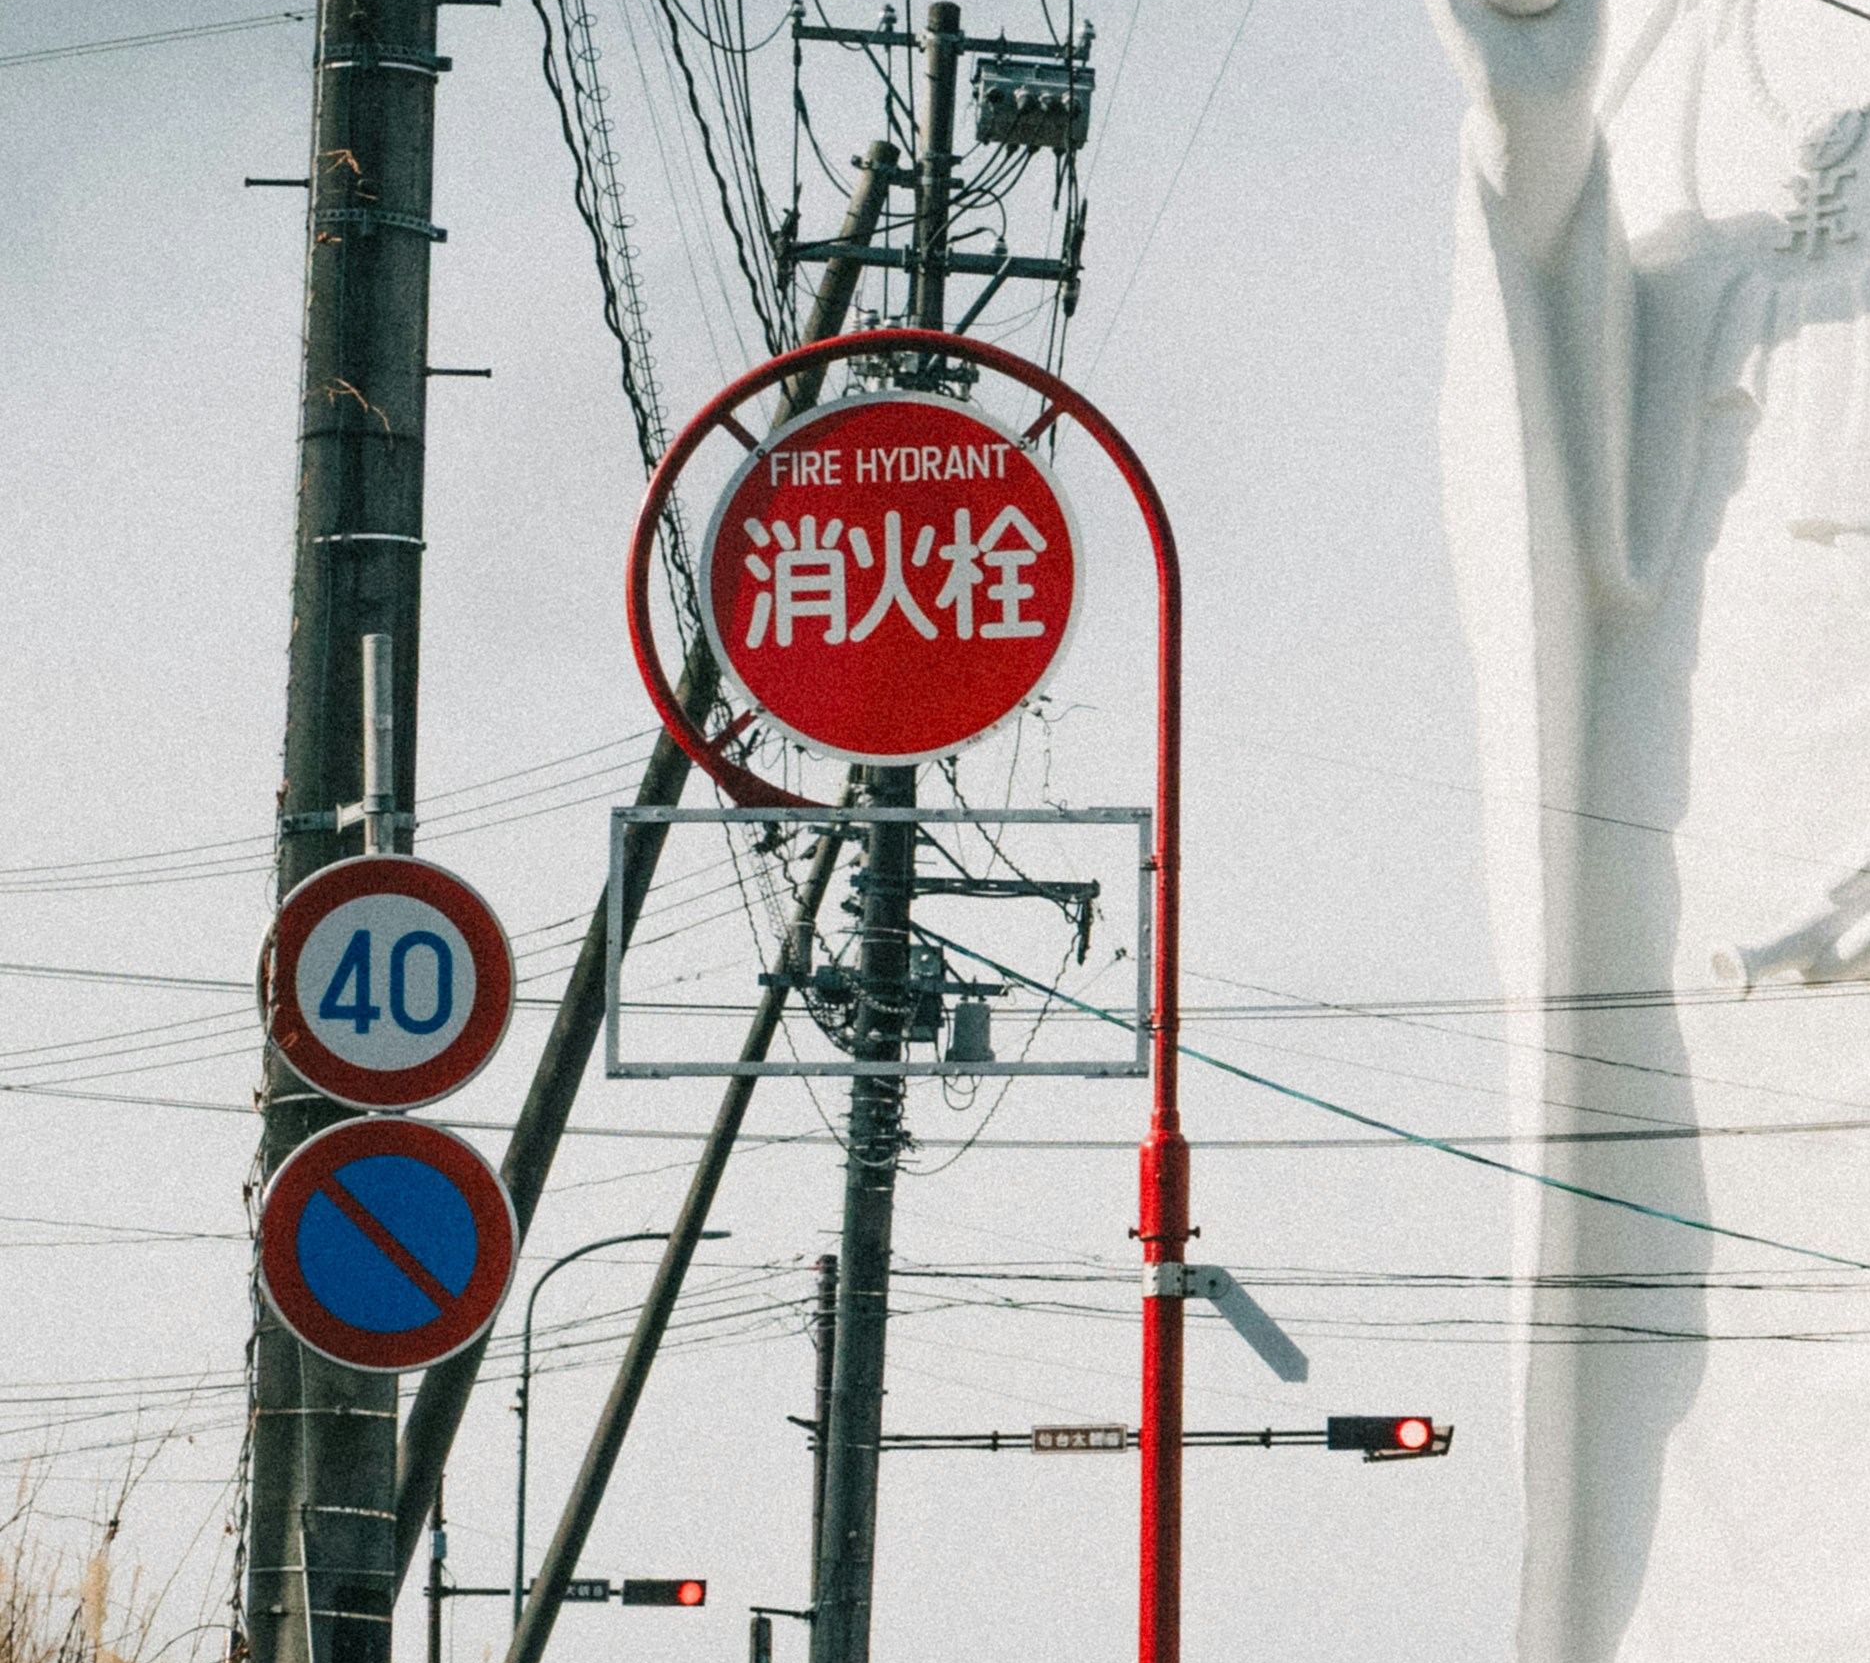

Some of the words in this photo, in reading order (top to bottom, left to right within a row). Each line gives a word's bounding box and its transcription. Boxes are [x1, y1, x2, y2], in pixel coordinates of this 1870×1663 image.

[770, 449, 842, 487] FIRE
[856, 444, 1011, 484] HYDRANT
[743, 504, 1047, 649] 消火栓
[319, 929, 453, 1035] 40
